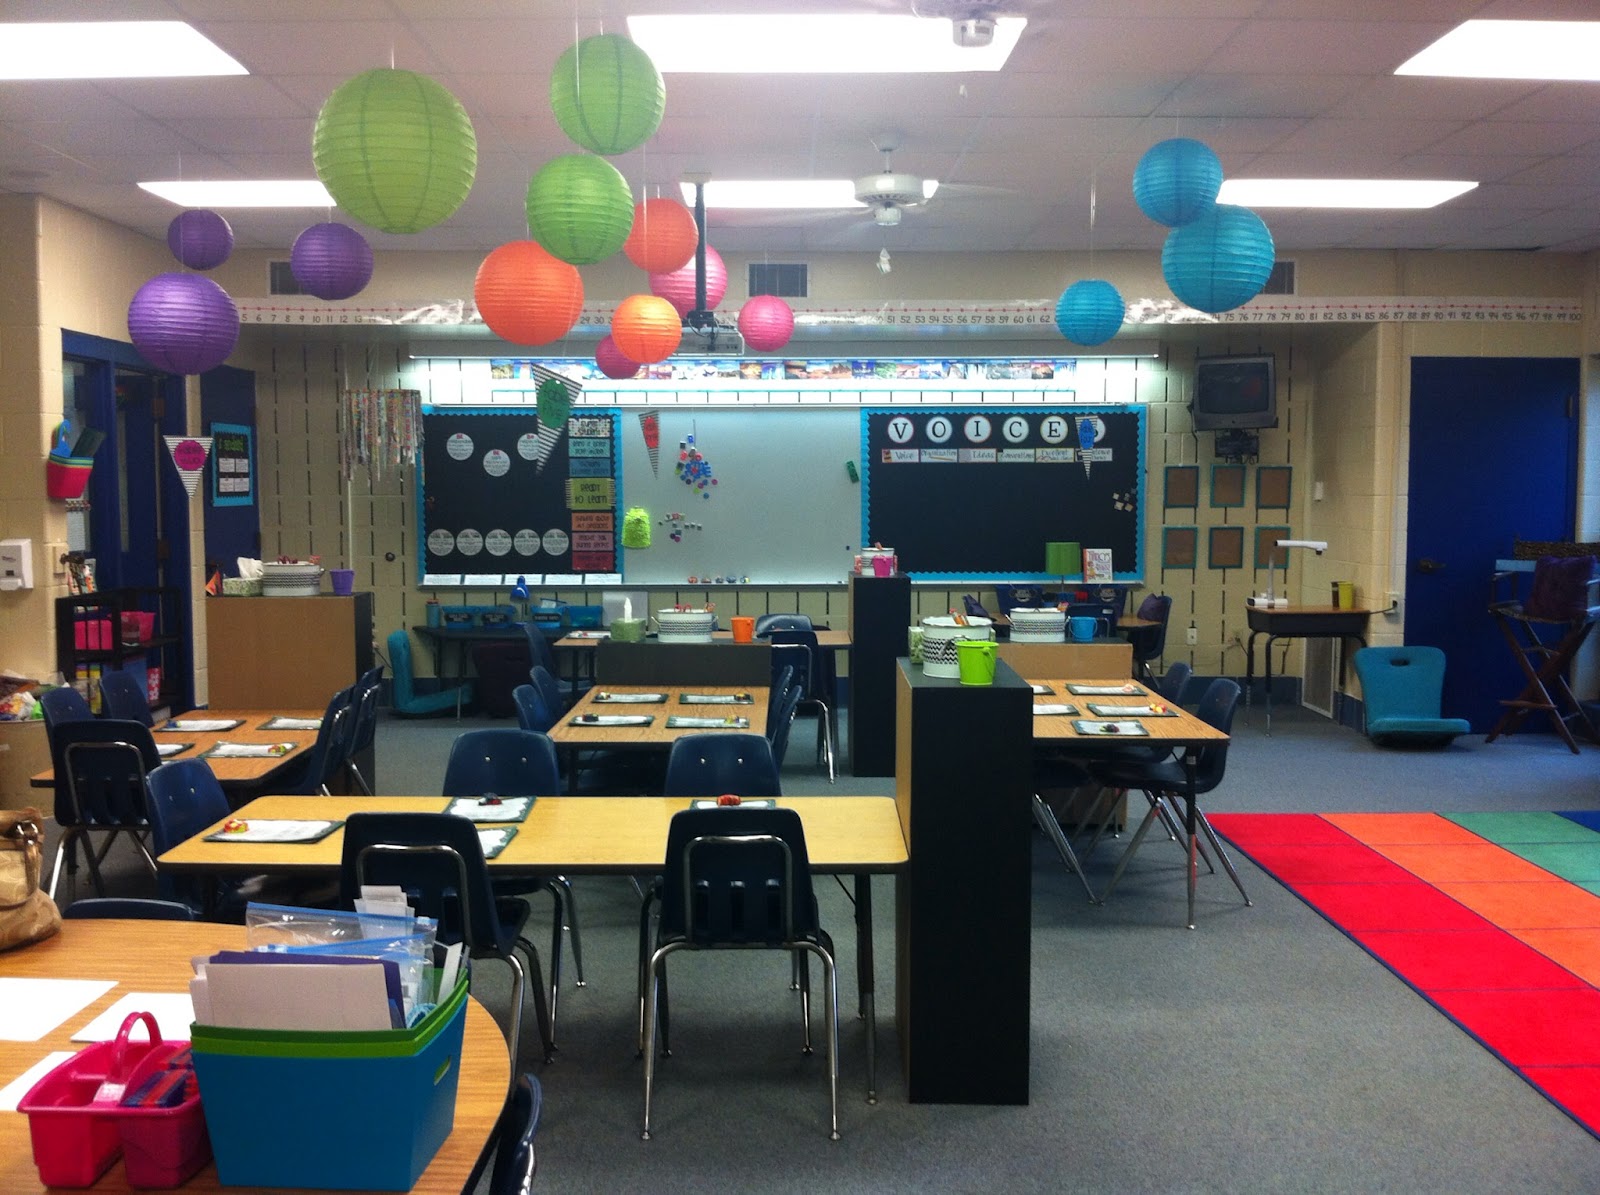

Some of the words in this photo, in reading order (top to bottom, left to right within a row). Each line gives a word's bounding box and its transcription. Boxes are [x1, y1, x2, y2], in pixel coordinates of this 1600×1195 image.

[1516, 312, 1526, 320] 96
[893, 423, 908, 440] V
[932, 420, 946, 438] O
[974, 420, 981, 437] I
[1009, 421, 1022, 438] C
[1047, 421, 1061, 438] E
[895, 451, 914, 460] Voice
[972, 451, 994, 459] Ideas
